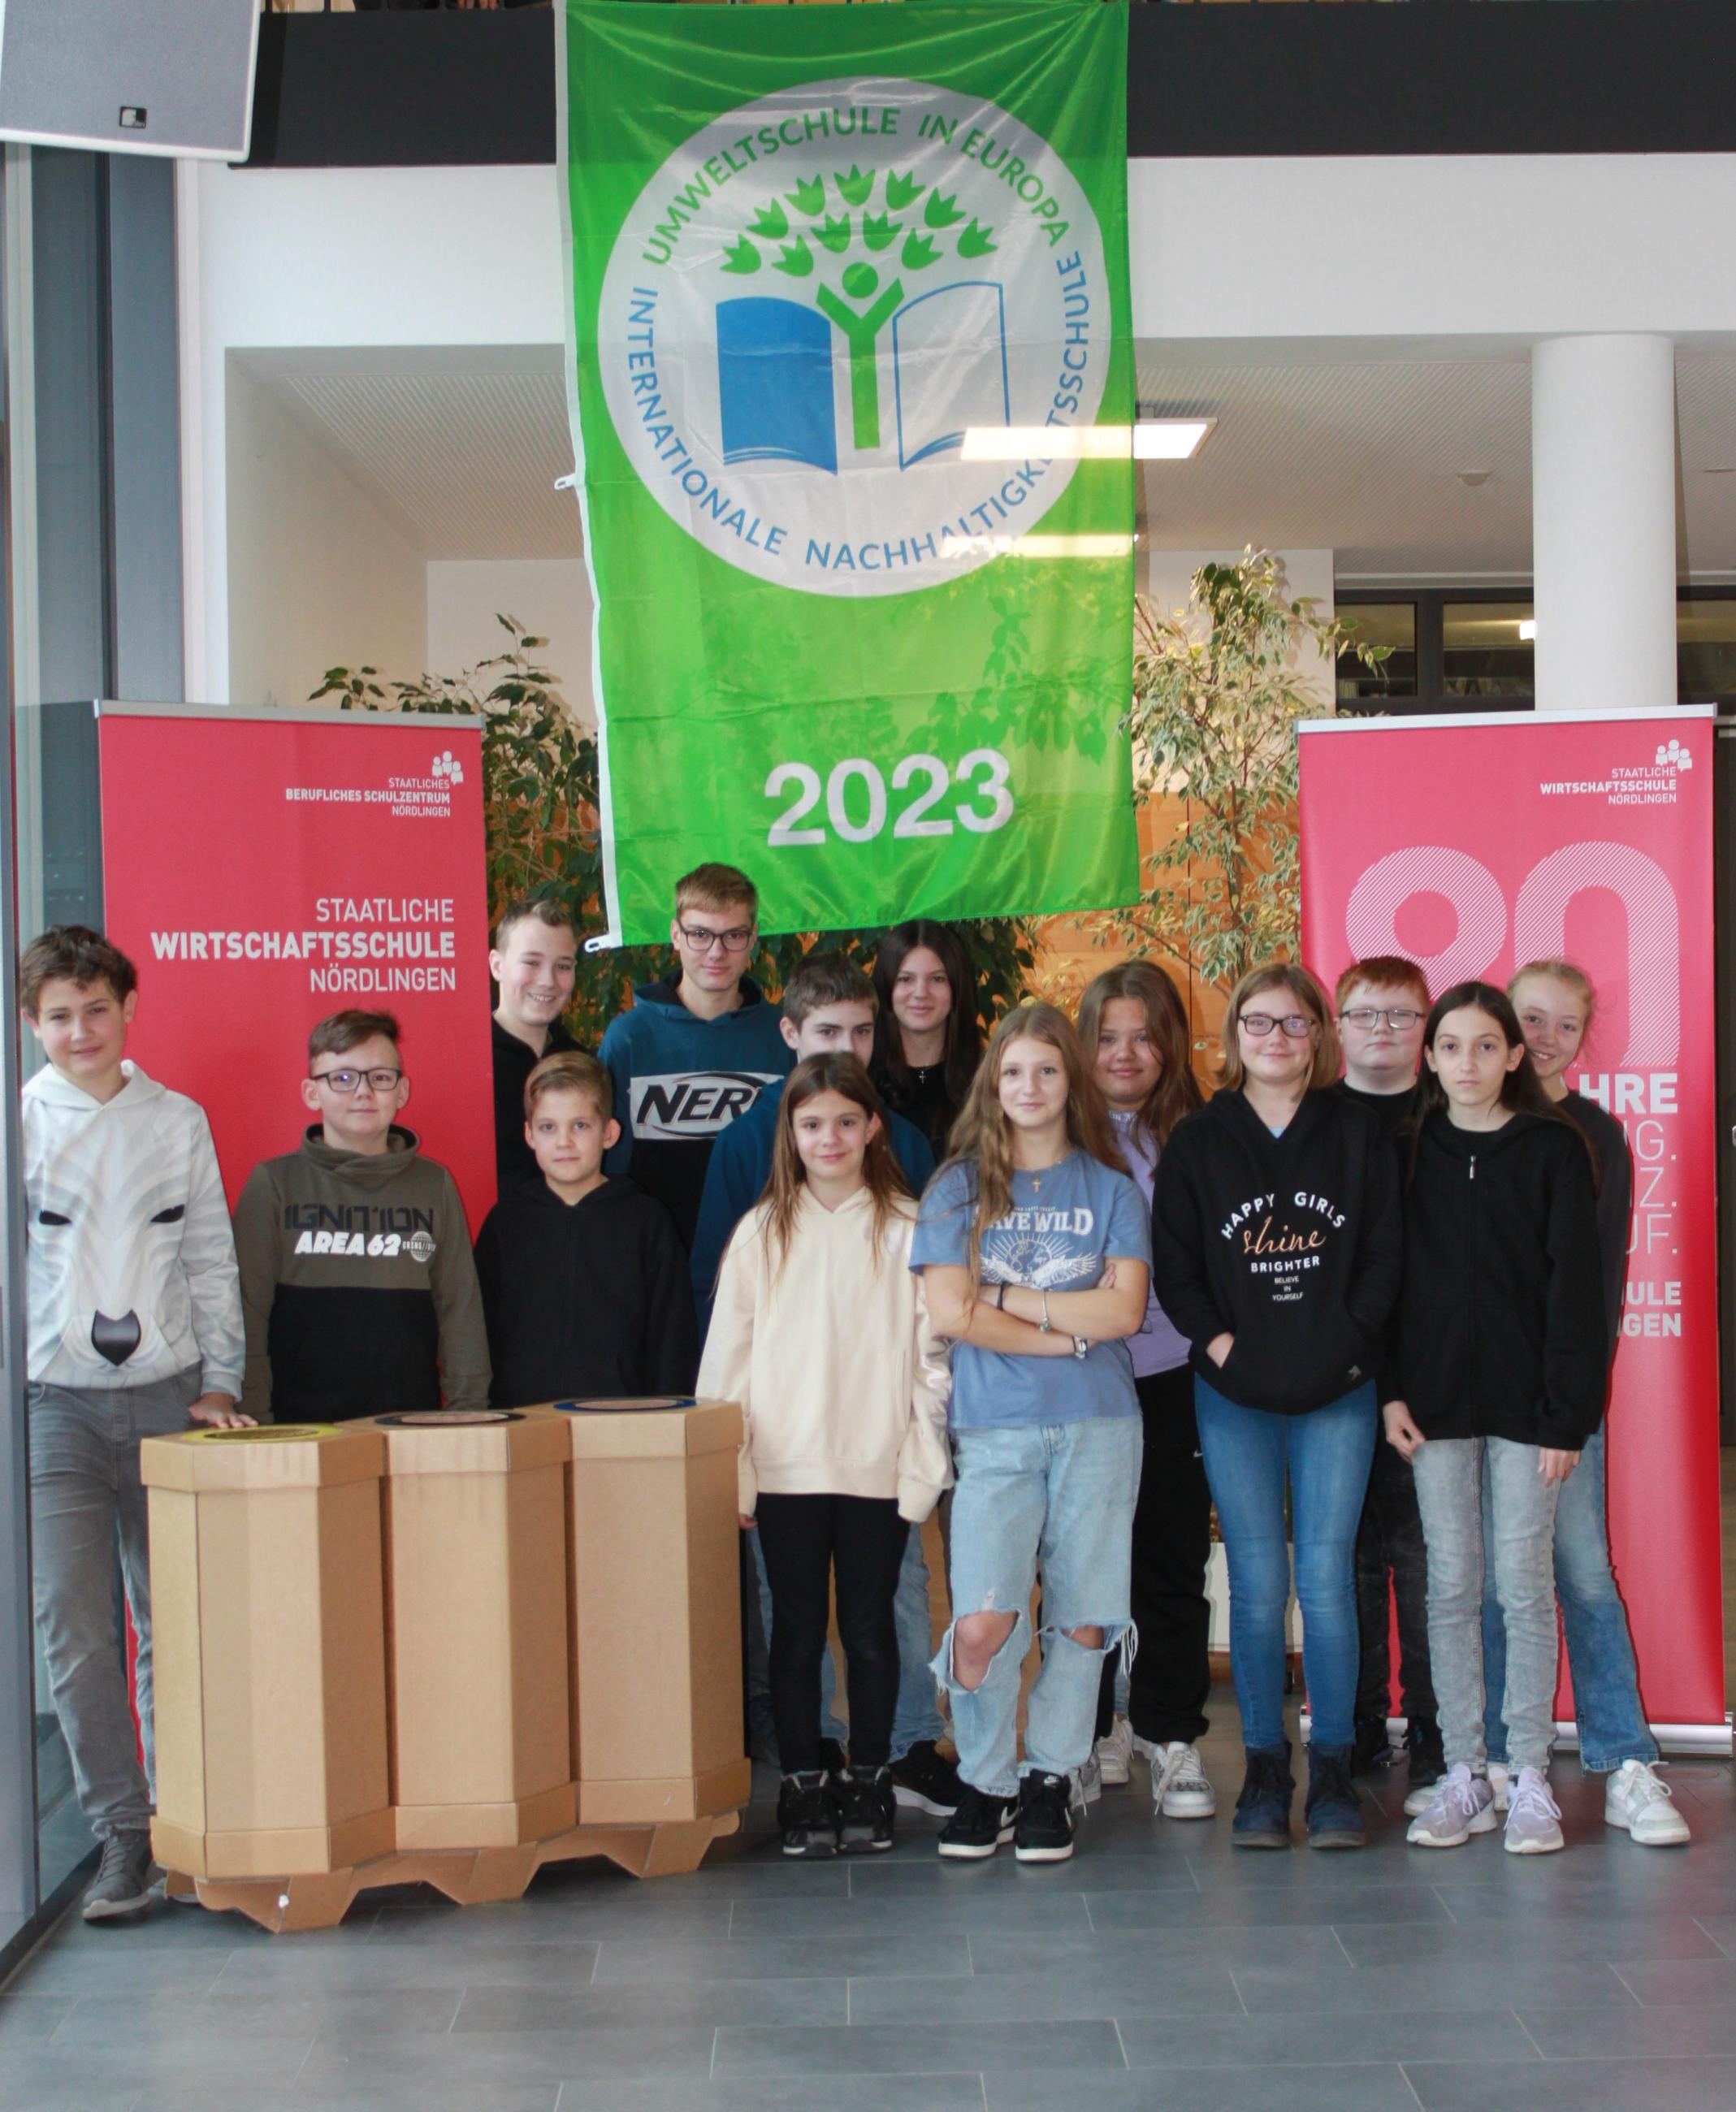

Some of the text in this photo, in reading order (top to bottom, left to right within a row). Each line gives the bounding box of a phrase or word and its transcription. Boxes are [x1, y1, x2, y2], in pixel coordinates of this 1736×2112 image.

[642, 107, 1070, 265] UMWELTSCHULE IN EUROPA
[628, 250, 1089, 571] INTERNATIONALE NACHHLTIGKTSSCHULE
[388, 777, 450, 790] STAATLICHES
[1612, 767, 1676, 778] STAATLICHE
[286, 788, 450, 803] BERUFLICHES SCHULZENTRUM
[764, 749, 1014, 846] 2023
[1540, 779, 1677, 794] WIRTSCHAFTSSCHULE
[1608, 793, 1677, 805] NÖRDLINGEN
[392, 803, 450, 817] NÖRDLINGEN
[316, 898, 454, 923] STAATLICHE
[151, 931, 456, 960] WIRTSCHAFTSSCHULE
[310, 963, 456, 992] NÖRDLINGEN
[636, 1084, 762, 1125] NER
[1578, 1072, 1678, 1114] HRE
[1033, 1207, 1094, 1236] WILD
[1221, 1192, 1345, 1240] HAPPY GIRLS
[294, 1231, 365, 1256] AREA
[367, 1233, 401, 1257] 62
[1244, 1215, 1327, 1256] shine
[1250, 1255, 1321, 1274] BRIGHTER
[1274, 1275, 1300, 1283] BELIEVE
[1272, 1292, 1303, 1301] YOURSELF
